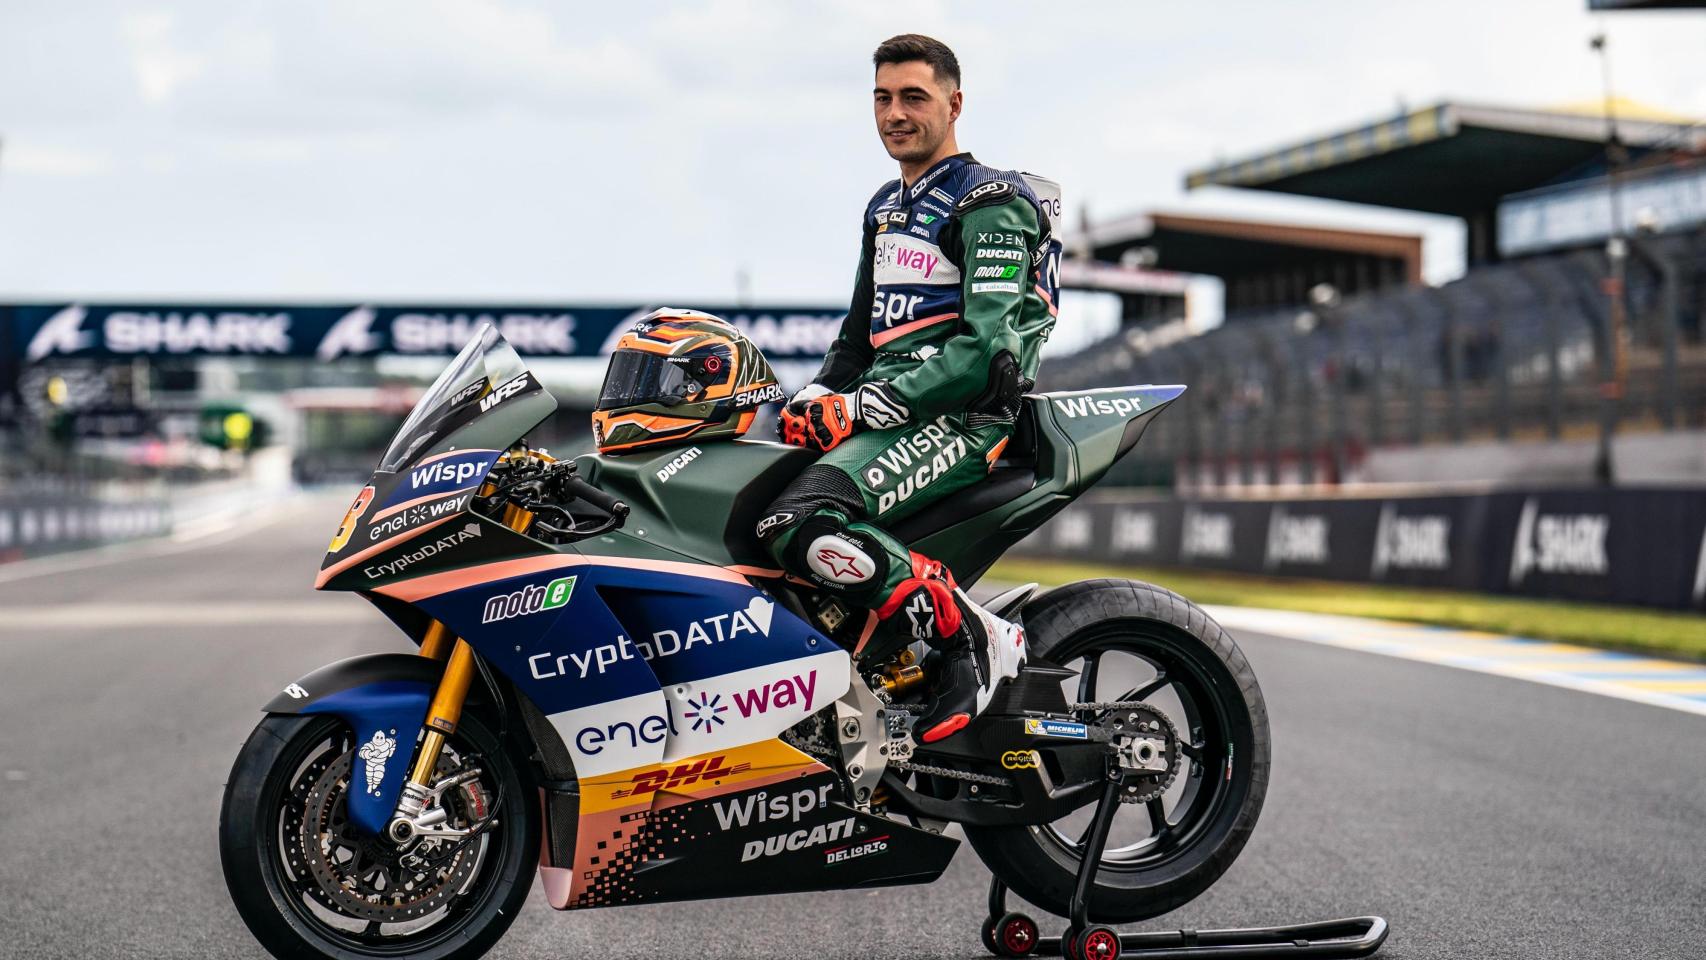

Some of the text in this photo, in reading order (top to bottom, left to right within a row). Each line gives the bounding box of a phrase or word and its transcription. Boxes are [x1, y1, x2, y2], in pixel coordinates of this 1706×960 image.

[896, 247, 938, 279] way
[976, 248, 1023, 261] DUCATI
[872, 285, 924, 328] spr
[104, 311, 292, 353] SHARK
[479, 373, 529, 413] WRS
[736, 383, 784, 407] SHARK
[1055, 395, 1142, 418] Wispr
[656, 446, 703, 483] DUCATI
[877, 415, 951, 475] Wispr
[411, 461, 489, 489] Wispr
[878, 436, 967, 515] DUCATI
[369, 495, 468, 541] enel way
[363, 530, 475, 579] CryptoDATA
[528, 608, 759, 681] CryptoDATA
[576, 669, 818, 756] enel way
[1046, 725, 1085, 735] MICHELIN
[631, 755, 732, 796] DHL
[712, 783, 834, 831] Wispr
[741, 817, 856, 863] DUCATI
